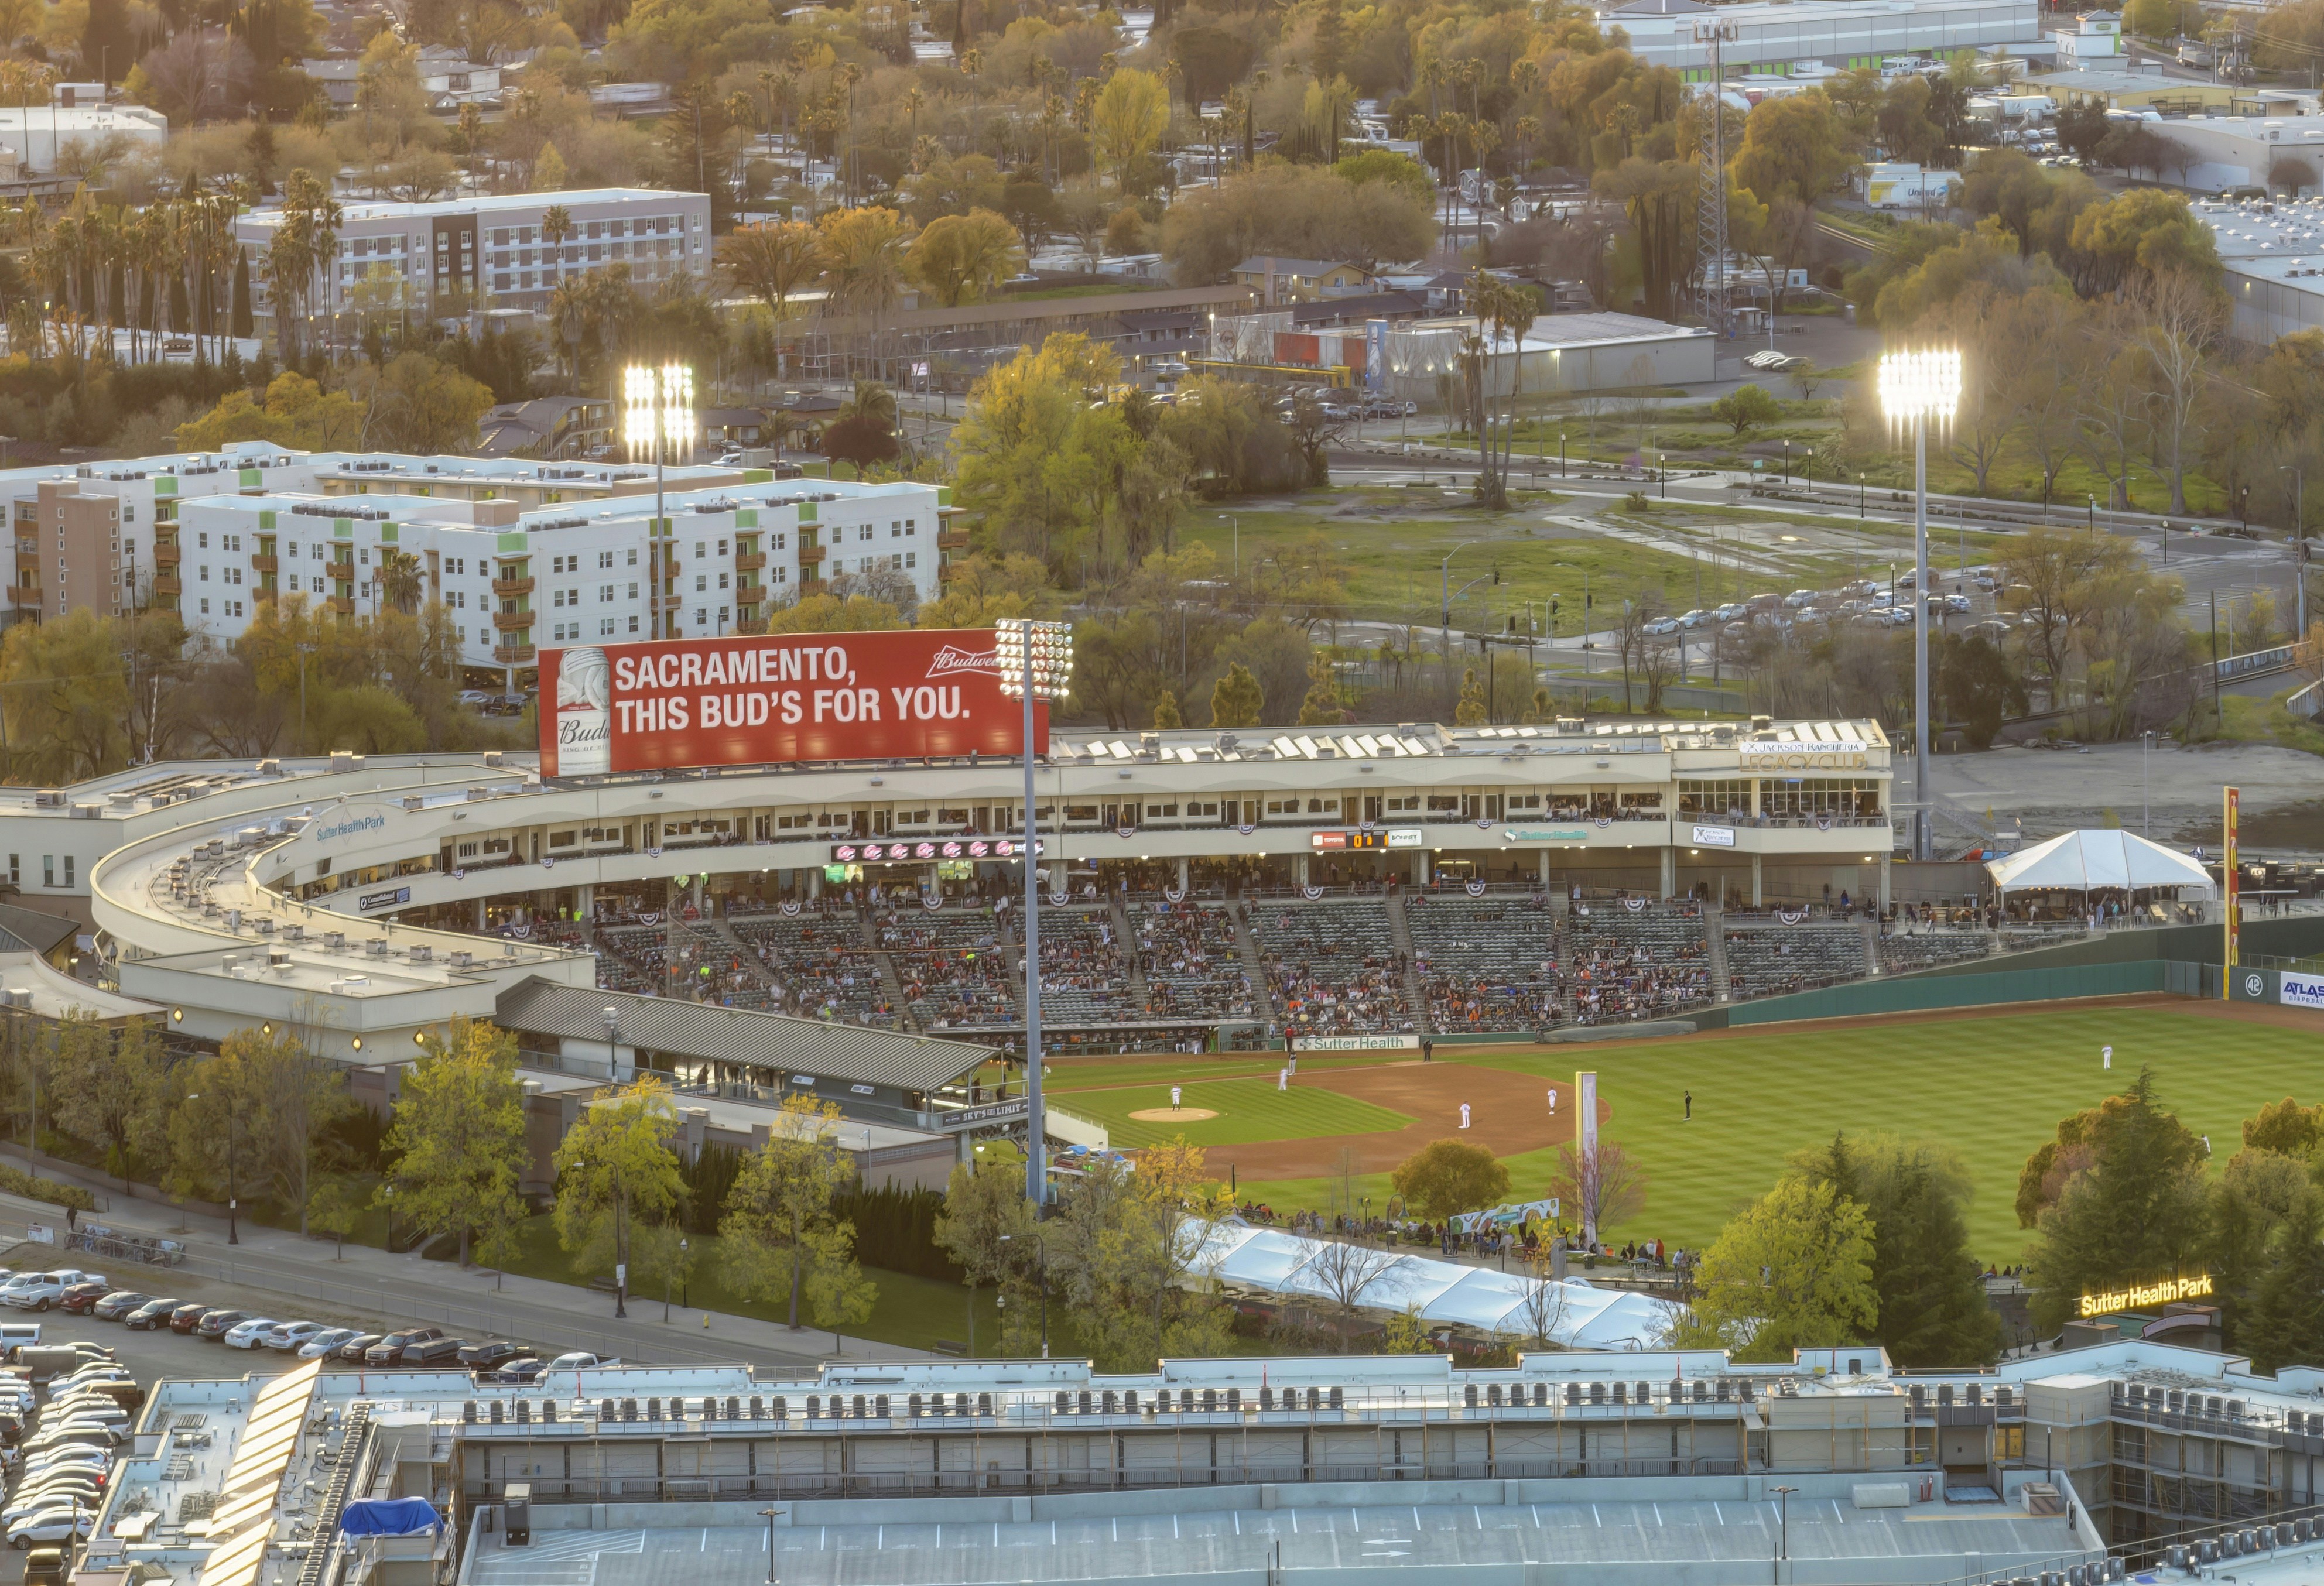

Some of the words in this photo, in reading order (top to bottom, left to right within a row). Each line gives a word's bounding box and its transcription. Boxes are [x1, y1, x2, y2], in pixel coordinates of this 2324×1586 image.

[1908, 187, 1936, 196] Unied
[615, 646, 857, 691] SACRAMENTO,
[616, 696, 689, 734] THIS
[700, 690, 803, 728] BUD'S
[814, 688, 881, 723] FOR
[892, 686, 970, 720] YOU.
[1760, 743, 1803, 752] JACKSON
[1740, 754, 1815, 772] LEGACY
[1819, 754, 1868, 771] CLUB
[317, 826, 338, 841] Sutter
[338, 820, 364, 835] Health
[365, 814, 385, 830] Park
[2247, 978, 2260, 992] 42
[2284, 982, 2324, 998] ATLAS
[1314, 1037, 1356, 1050] Sutter
[1360, 1036, 1404, 1049] Health
[995, 1104, 1021, 1115] LIMIT
[2081, 1293, 2128, 1316] Sutter
[2129, 1280, 2178, 1307] Health
[2178, 1275, 2212, 1299] Park
